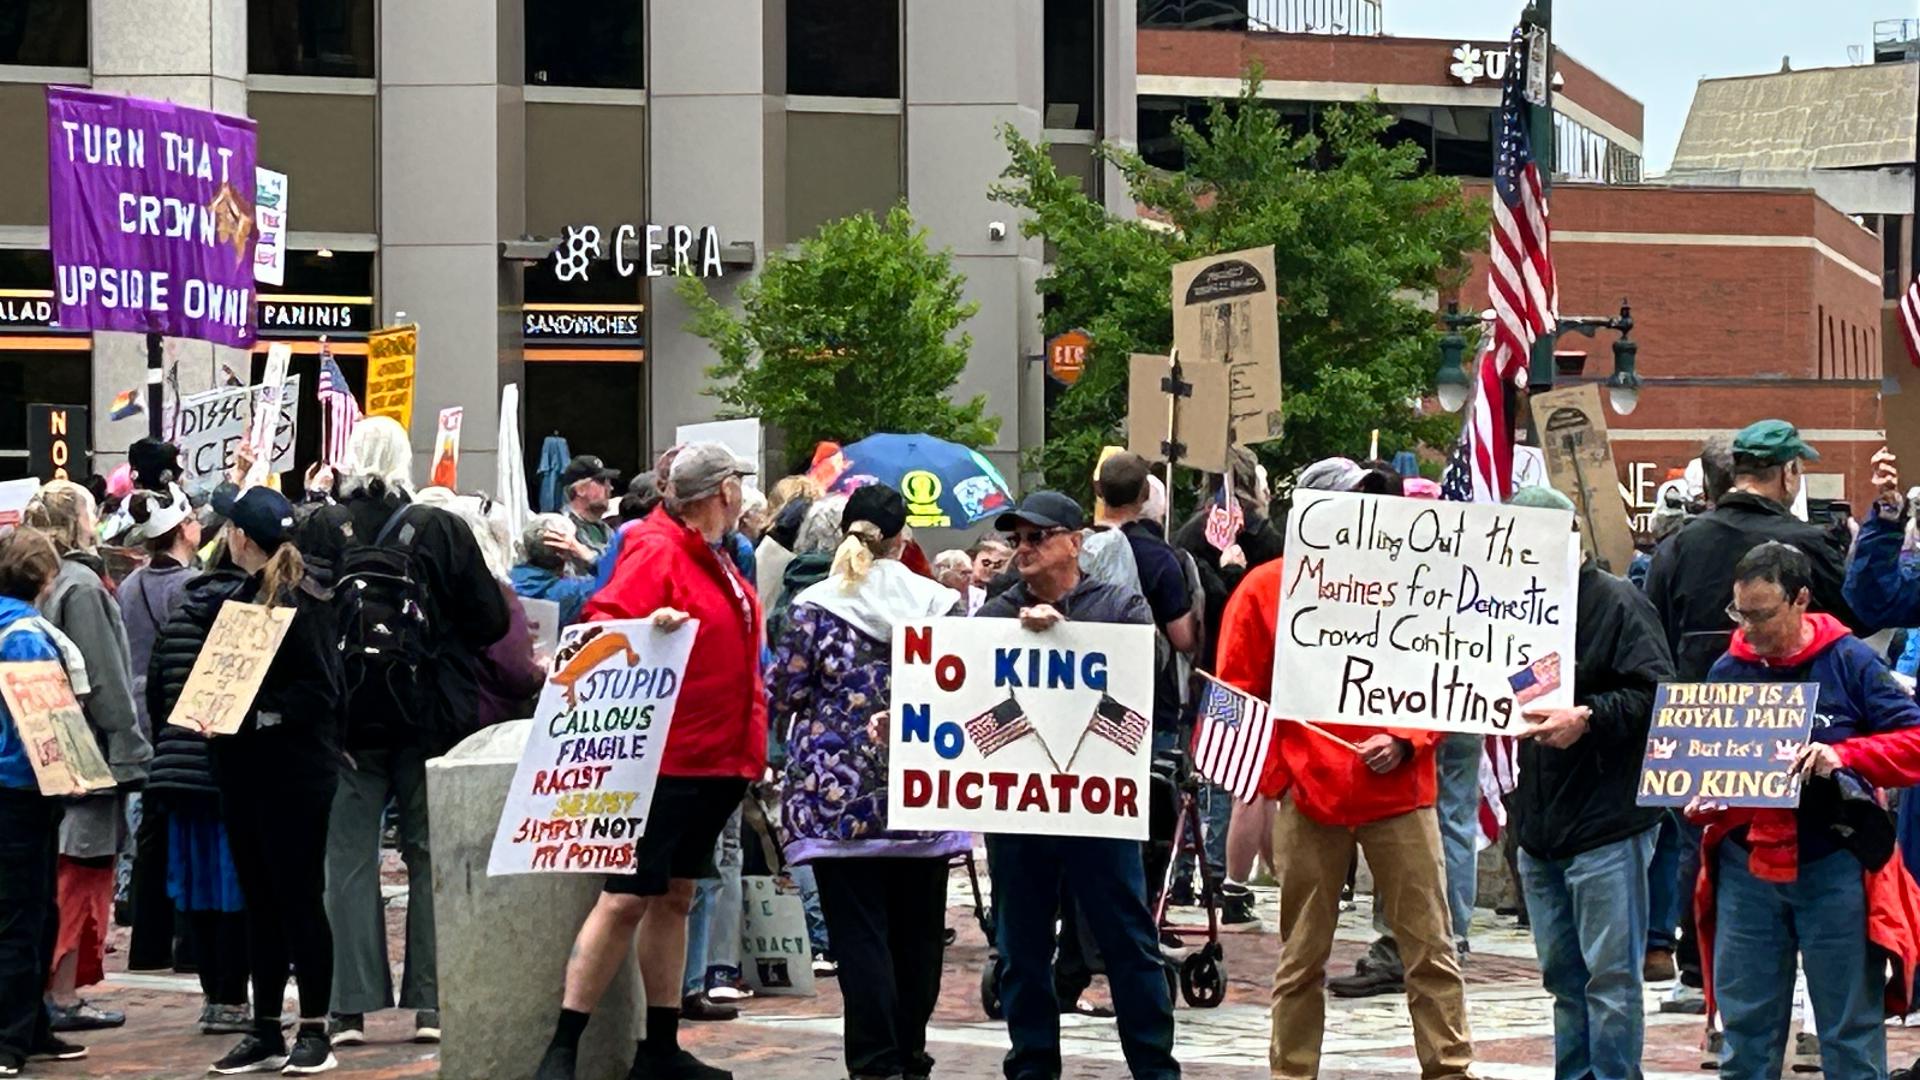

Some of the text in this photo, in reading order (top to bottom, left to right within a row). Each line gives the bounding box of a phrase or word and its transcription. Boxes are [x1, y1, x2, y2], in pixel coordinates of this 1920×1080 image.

[62, 121, 233, 184] TURN THAT
[614, 225, 723, 277] CERA
[58, 264, 169, 312] UPSIDE
[264, 304, 352, 327] PANINIS
[1299, 498, 1540, 567] Calling Out the
[1286, 555, 1560, 626] Marines for Domestic
[1290, 606, 1381, 649] Crowd
[1389, 614, 1493, 663] Control
[904, 625, 1108, 692] NO KING
[579, 667, 677, 703] STUPID
[1337, 654, 1513, 730] Revolting
[1758, 684, 1783, 706] IS
[1786, 684, 1805, 706] A
[549, 704, 655, 738] CALLOUS
[901, 703, 965, 760] NO
[1657, 707, 1807, 729] ROYAL PAIN
[556, 734, 648, 766] FRAGILE
[1687, 739, 1722, 758] But
[532, 765, 613, 796] RACIST
[903, 769, 1139, 817] DICTATOR
[1641, 769, 1692, 796] NO
[552, 790, 640, 818] SEXIST
[512, 817, 643, 844] SIMPLY NOT
